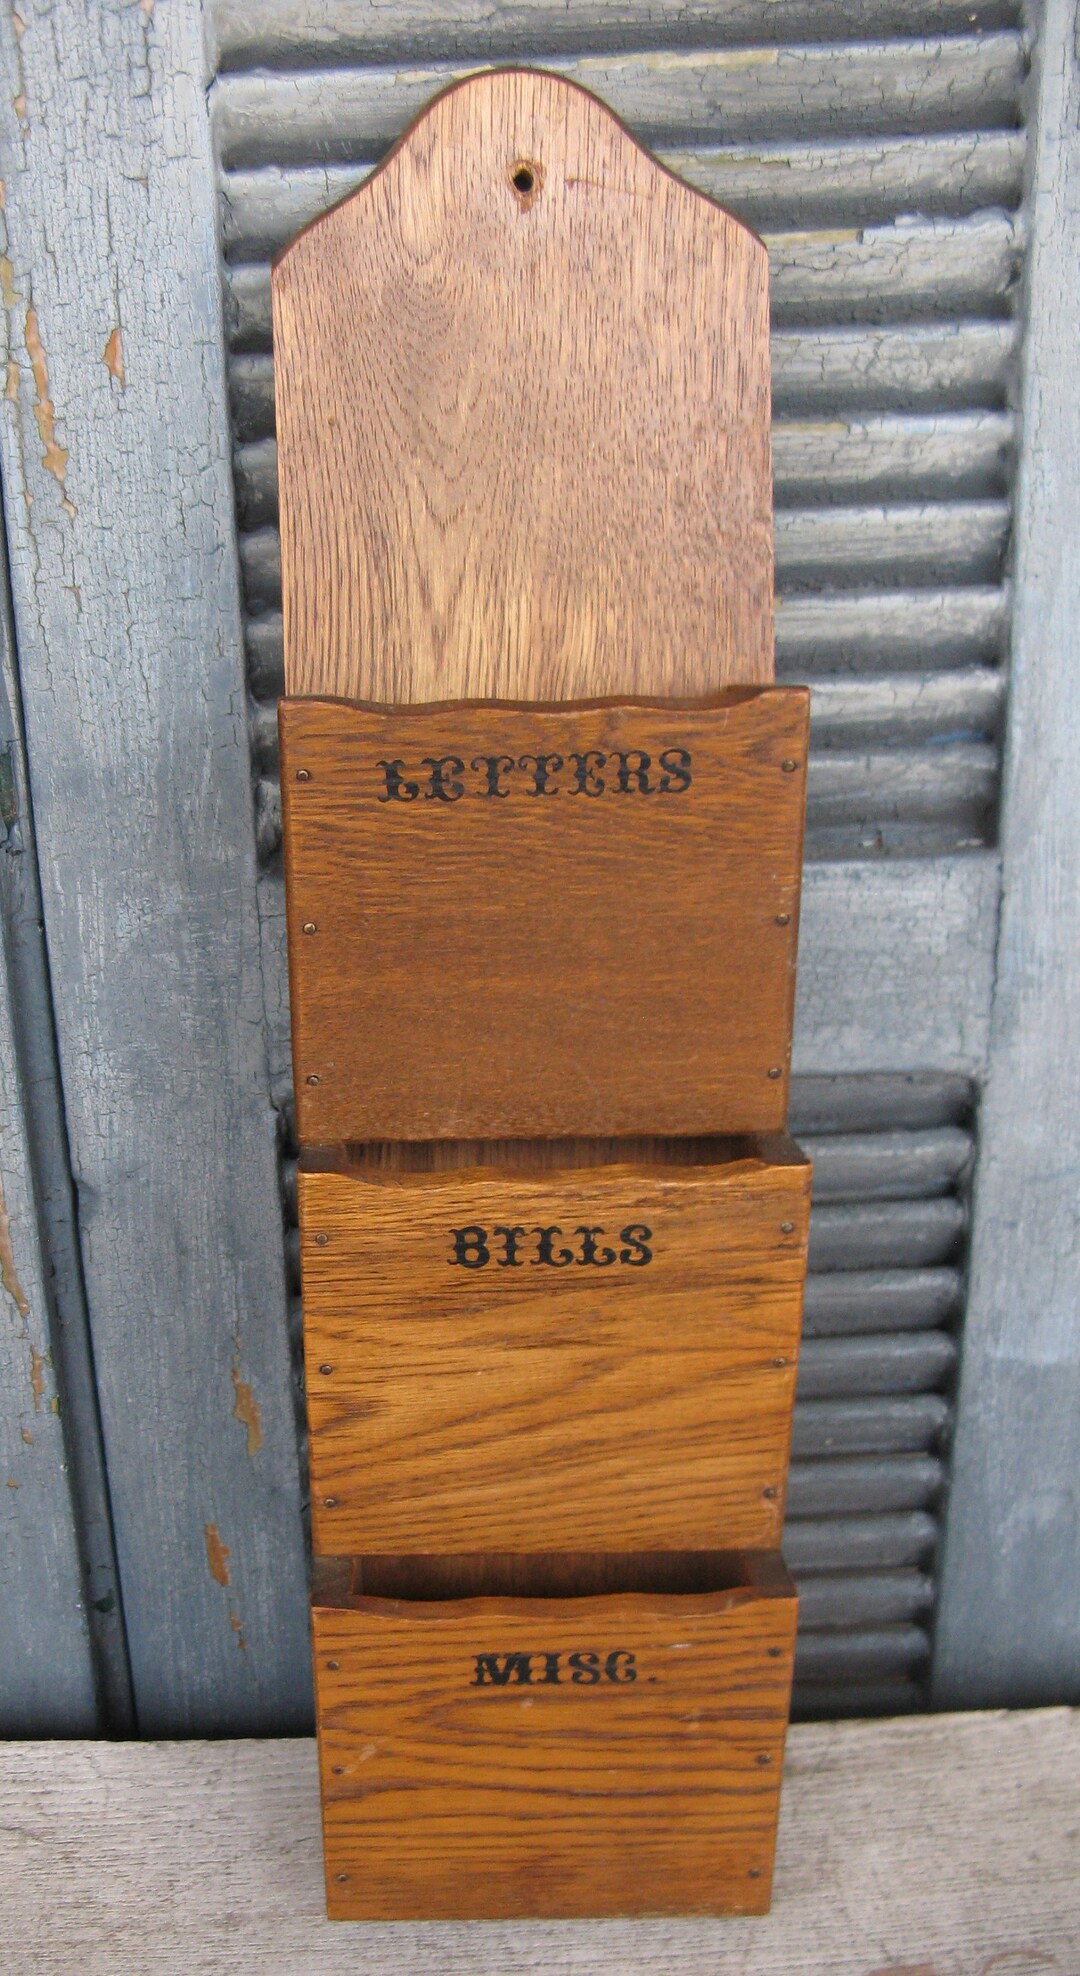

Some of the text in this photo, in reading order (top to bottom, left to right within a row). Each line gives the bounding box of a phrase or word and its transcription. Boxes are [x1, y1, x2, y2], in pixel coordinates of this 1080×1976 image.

[376, 748, 692, 803] LETTERS
[447, 1224, 653, 1269] BILLS
[470, 1651, 657, 1686] MISC.
